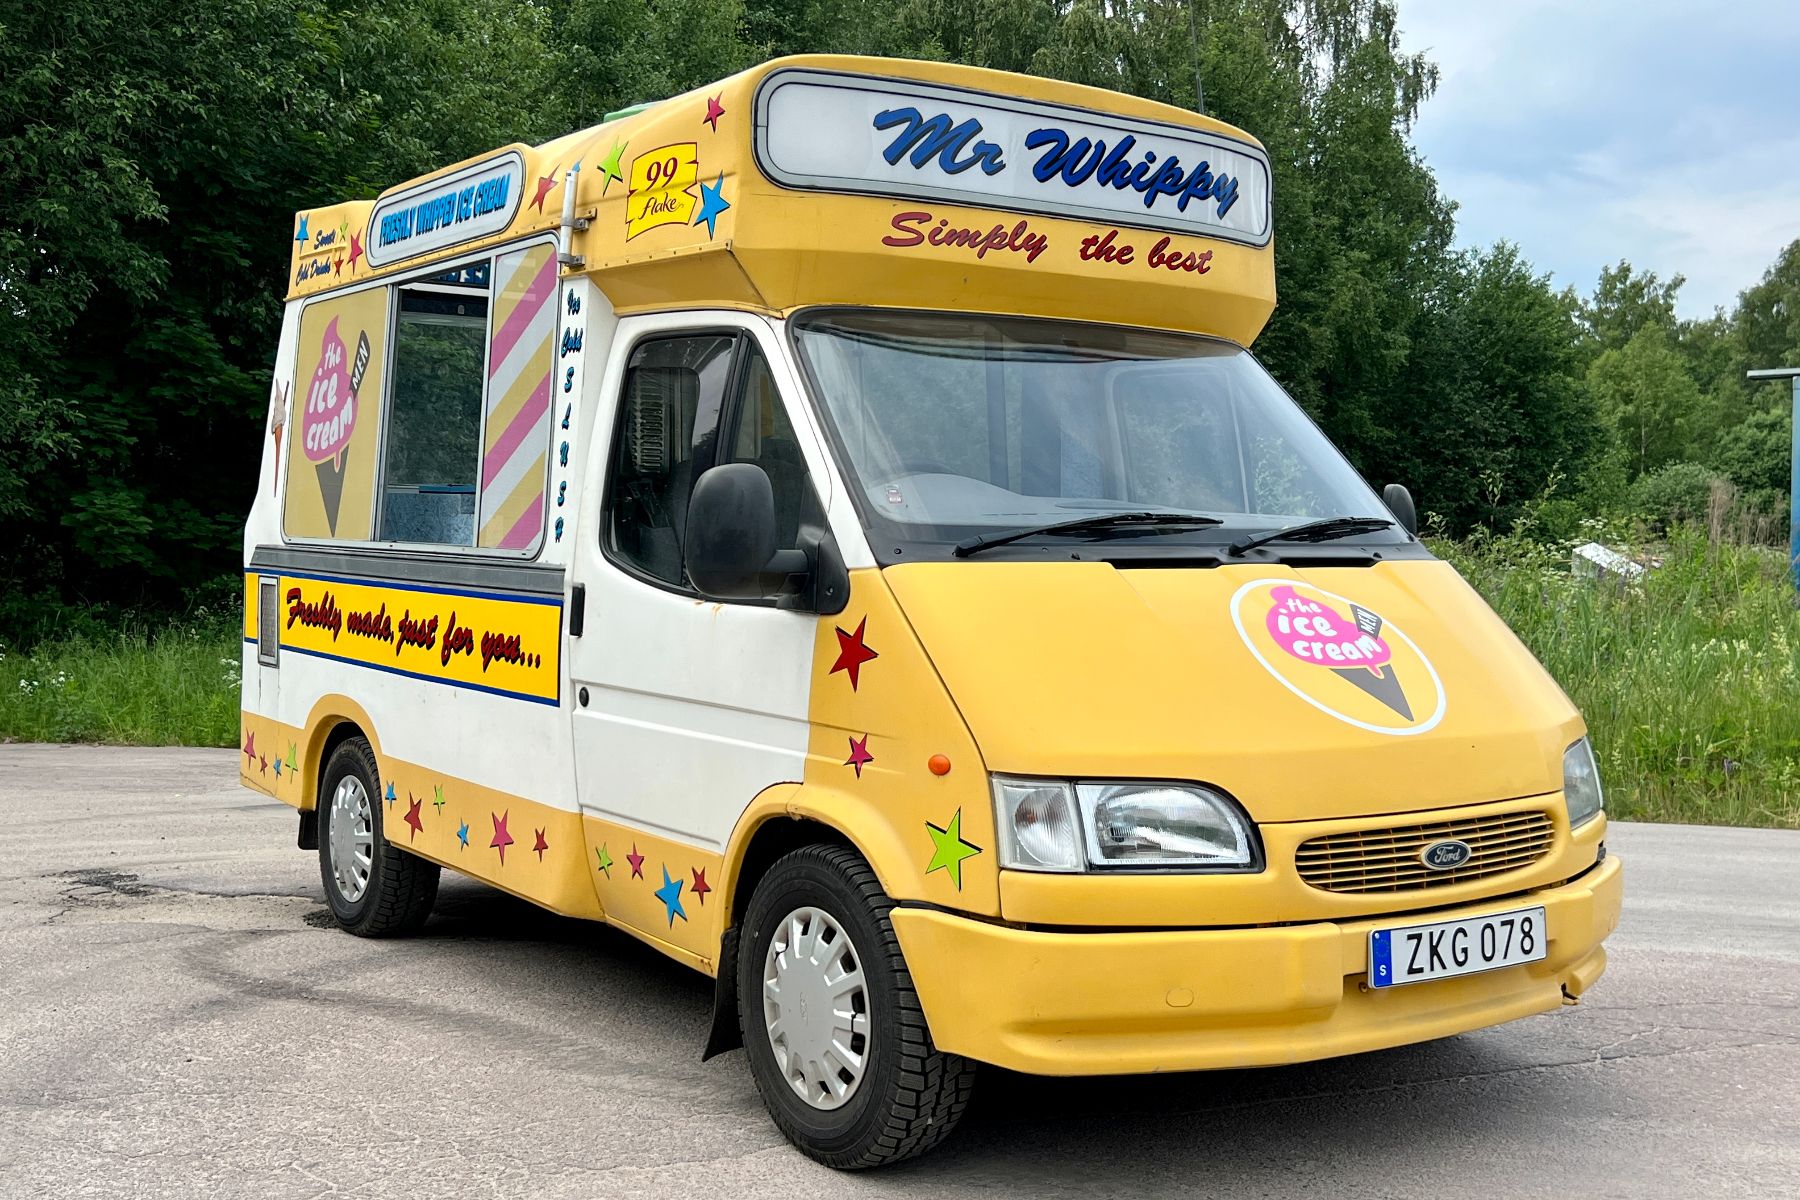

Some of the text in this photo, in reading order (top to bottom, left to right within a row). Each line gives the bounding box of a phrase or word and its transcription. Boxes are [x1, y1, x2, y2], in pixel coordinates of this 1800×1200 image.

[646, 157, 678, 191] 99
[872, 106, 1239, 220] Mr Whippy
[379, 173, 511, 248] FRESHLY WHIPPED ICE CREAM
[882, 211, 1214, 275] Simply the best
[324, 342, 341, 370] the
[352, 340, 369, 390] MEN
[309, 367, 338, 414] ice
[306, 395, 353, 452] cream
[1277, 608, 1337, 637] ice
[1285, 598, 1322, 614] the
[1356, 608, 1378, 634] MEN
[286, 587, 541, 673] Freshly made, just for you...
[1292, 634, 1383, 661] cream
[1433, 846, 1461, 863] Ford
[1406, 916, 1534, 975] ZKG 078
[1379, 964, 1387, 976] S
